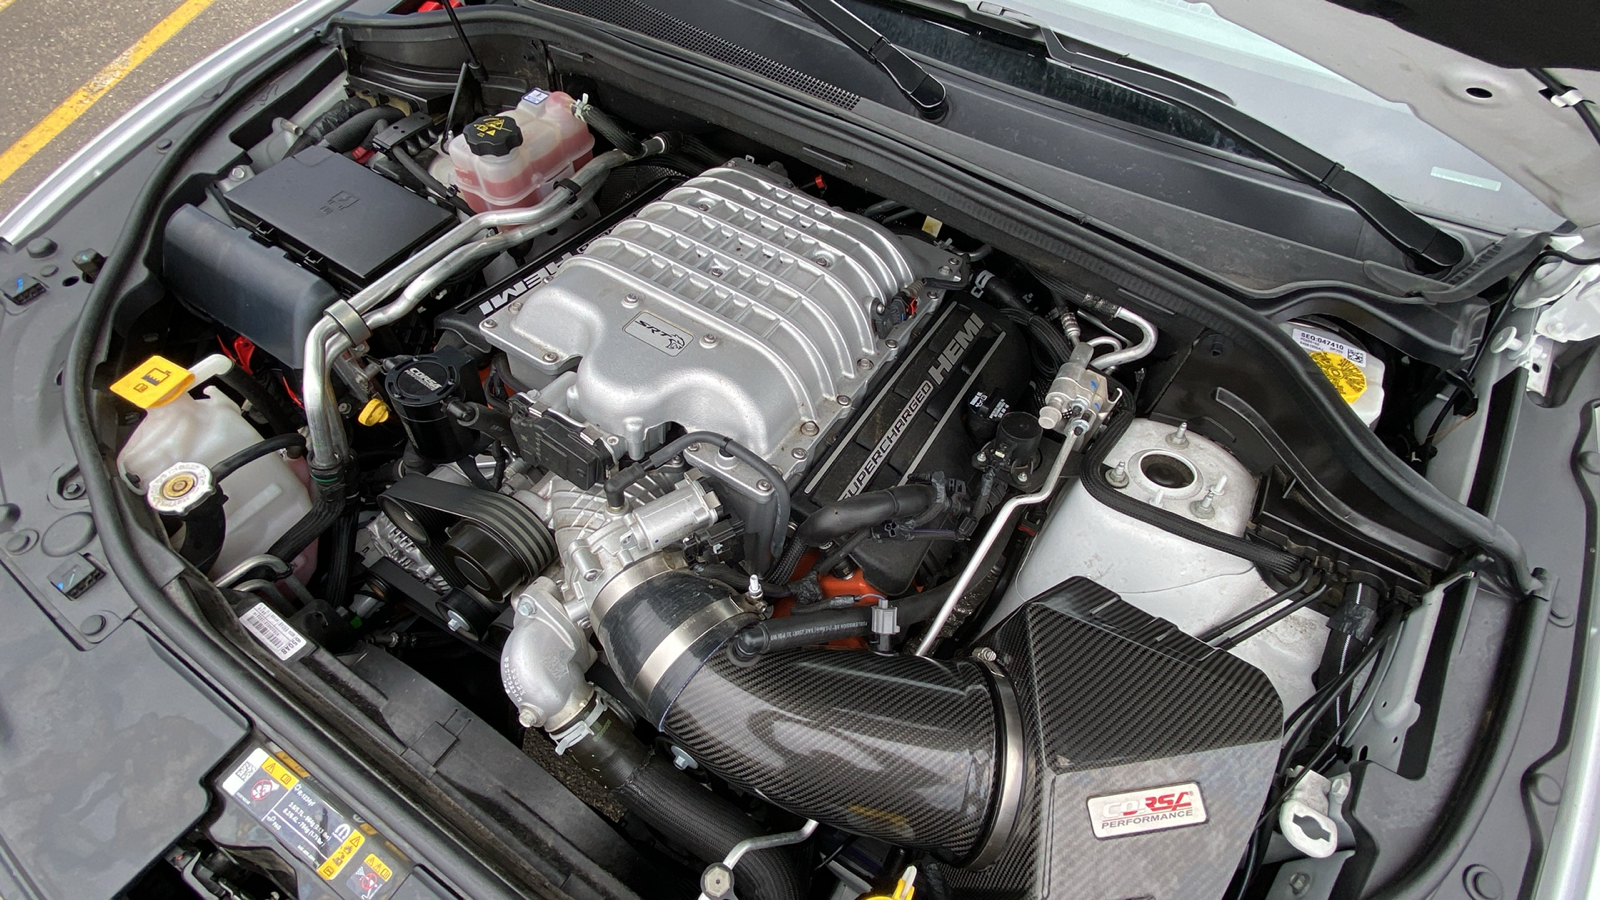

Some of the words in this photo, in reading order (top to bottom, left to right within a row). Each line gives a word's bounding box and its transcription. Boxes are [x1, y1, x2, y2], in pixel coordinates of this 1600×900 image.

[479, 252, 577, 316] HEMI
[635, 319, 672, 338] SRT
[928, 313, 984, 385] HEMI
[409, 367, 442, 389] CORSA
[1103, 791, 1192, 818] CORSA
[1101, 810, 1193, 829] PERFORMANCE
